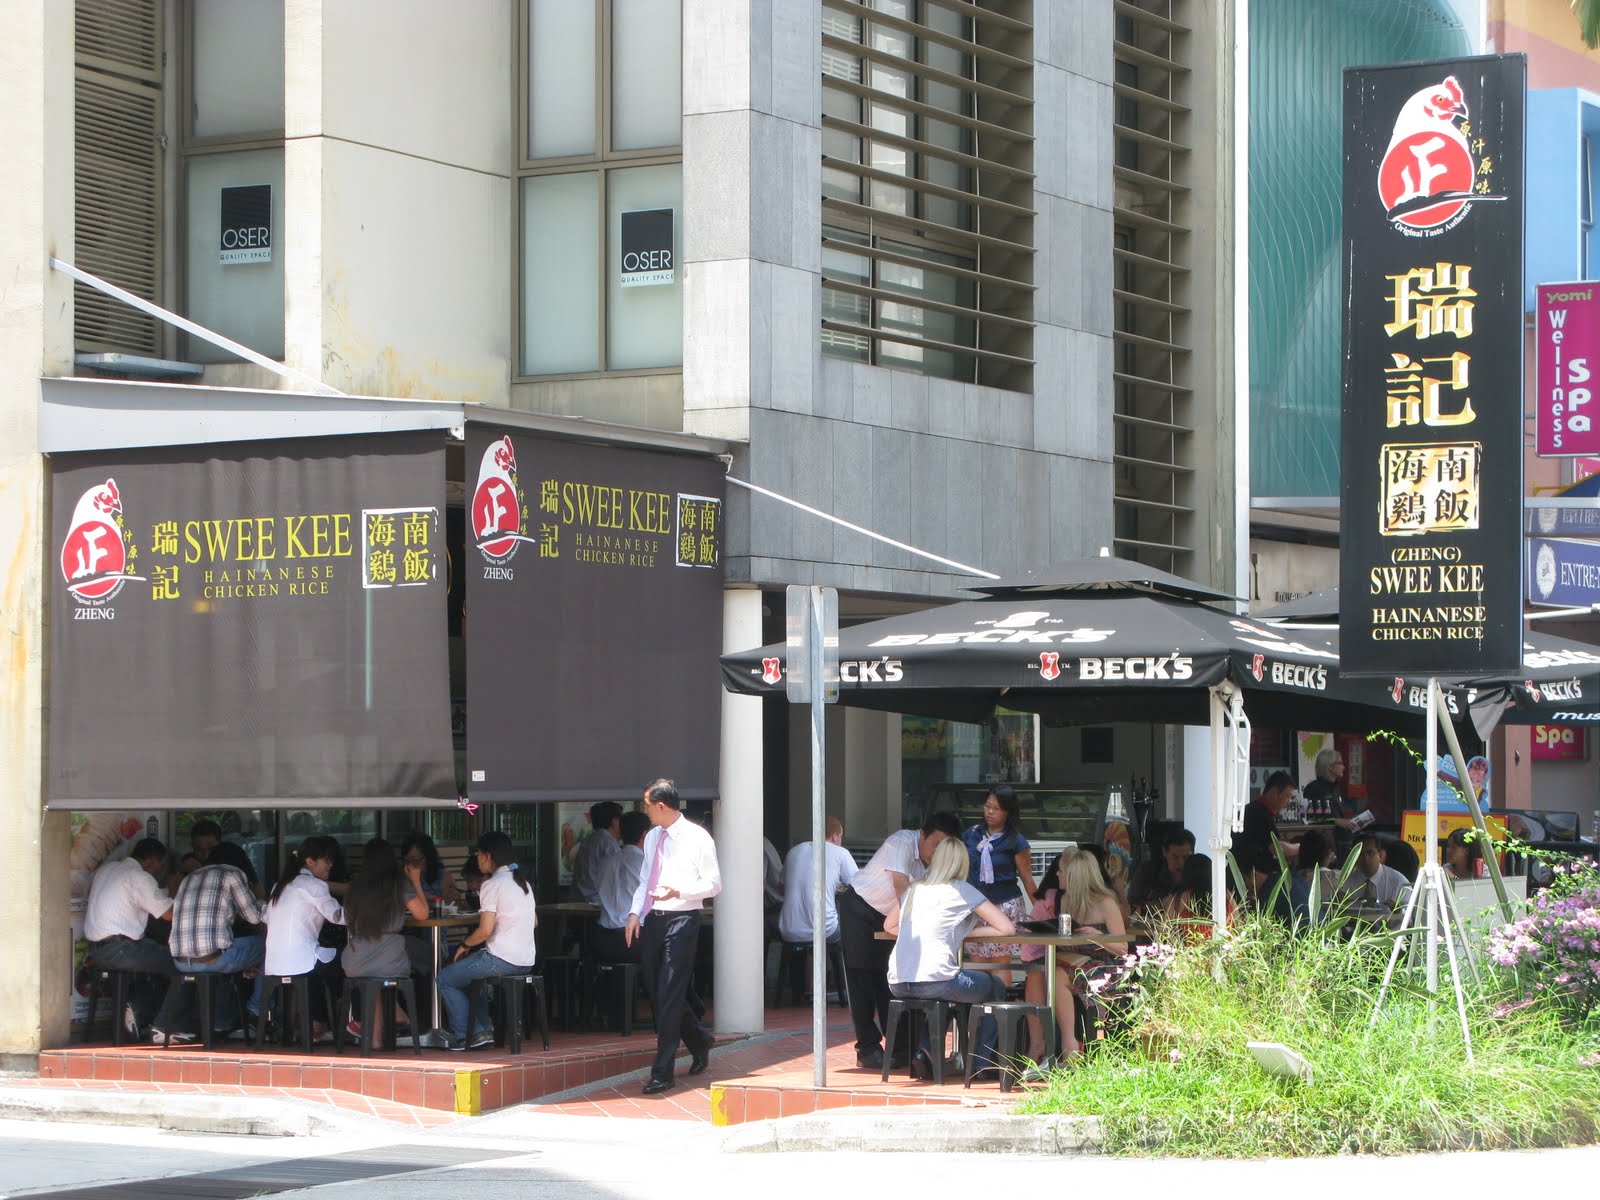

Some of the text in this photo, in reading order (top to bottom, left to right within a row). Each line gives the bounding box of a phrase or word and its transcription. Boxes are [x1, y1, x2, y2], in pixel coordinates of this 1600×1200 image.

[1394, 202, 1473, 238] Original Taste Authentic
[222, 226, 269, 248] OSER
[250, 251, 271, 259] SPACE
[623, 249, 671, 271] OSER
[621, 273, 674, 283] QUALITY SPACE
[1547, 289, 1592, 304] yomi
[1384, 262, 1478, 428] 瑞記
[1549, 309, 1567, 448] Wellness
[1391, 449, 1470, 484] 海南
[540, 479, 560, 558] 瑞記
[562, 482, 671, 534] SWEE KEE
[681, 499, 716, 532] 海南
[184, 513, 353, 564] SWEE KEE
[368, 512, 430, 547] 海南
[576, 533, 659, 553] HAINANESE
[151, 520, 180, 600] 瑞記
[575, 548, 655, 568] CHICKEN RICE
[1391, 547, 1462, 564] (ZHENG)
[204, 565, 334, 583] HAINANESE
[483, 566, 514, 580] ZHENG
[1370, 565, 1485, 594] SWEE KEE
[204, 582, 329, 599] CHICKEN RICE
[74, 607, 115, 620] ZHENG
[1372, 606, 1487, 624] HAINANESE
[1372, 626, 1484, 641] CHICKEN RICE
[832, 656, 904, 683] CK'S
[1079, 652, 1193, 680] BECK'S
[1271, 662, 1328, 690] BECK'S
[1409, 686, 1459, 714] BE'S
[1540, 677, 1583, 701] BECK'S
[1535, 725, 1575, 749] Spa
